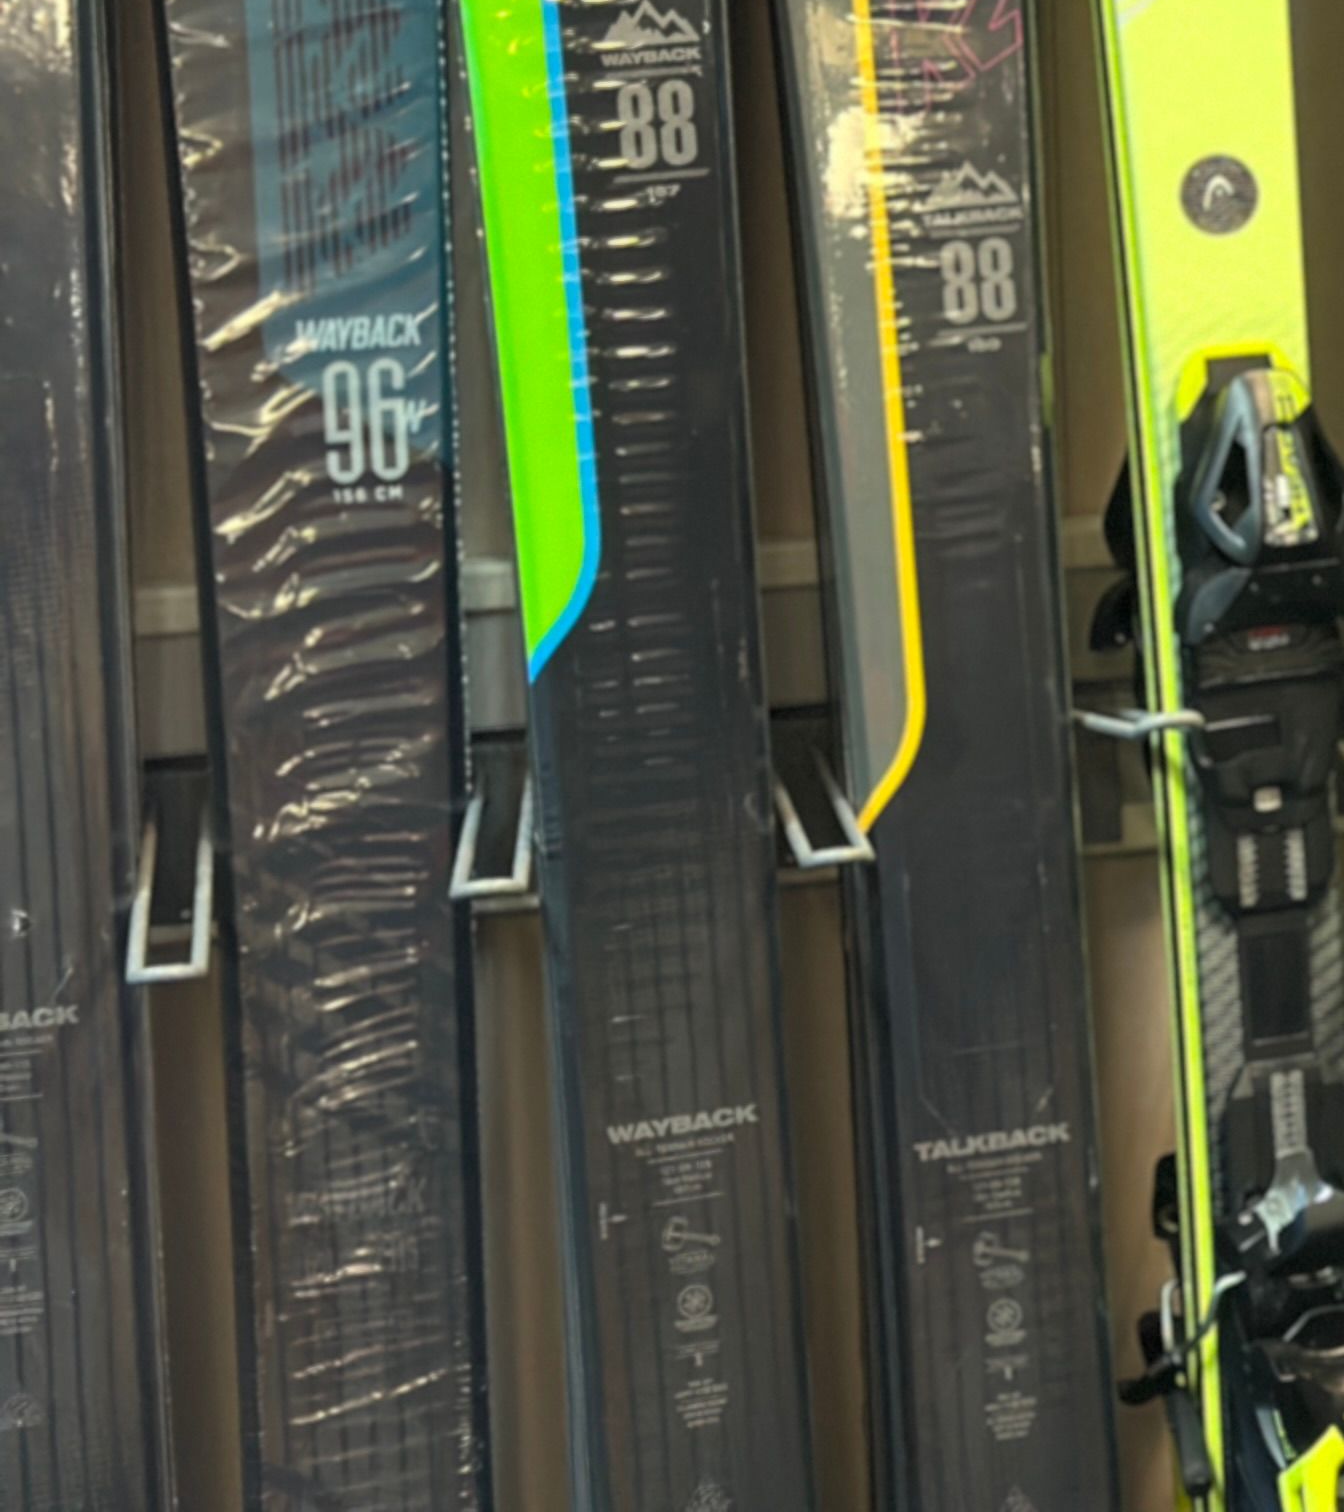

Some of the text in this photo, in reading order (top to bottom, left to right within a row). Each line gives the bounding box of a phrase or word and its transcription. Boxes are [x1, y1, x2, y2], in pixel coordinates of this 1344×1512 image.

[602, 46, 702, 68] WAYBACK
[617, 79, 699, 170] 88
[940, 236, 1018, 325] 88
[294, 313, 423, 354] WAYBACK
[321, 357, 411, 486] 96
[606, 1103, 758, 1145] WAYBACK
[913, 1122, 1072, 1162] TALKBACK
